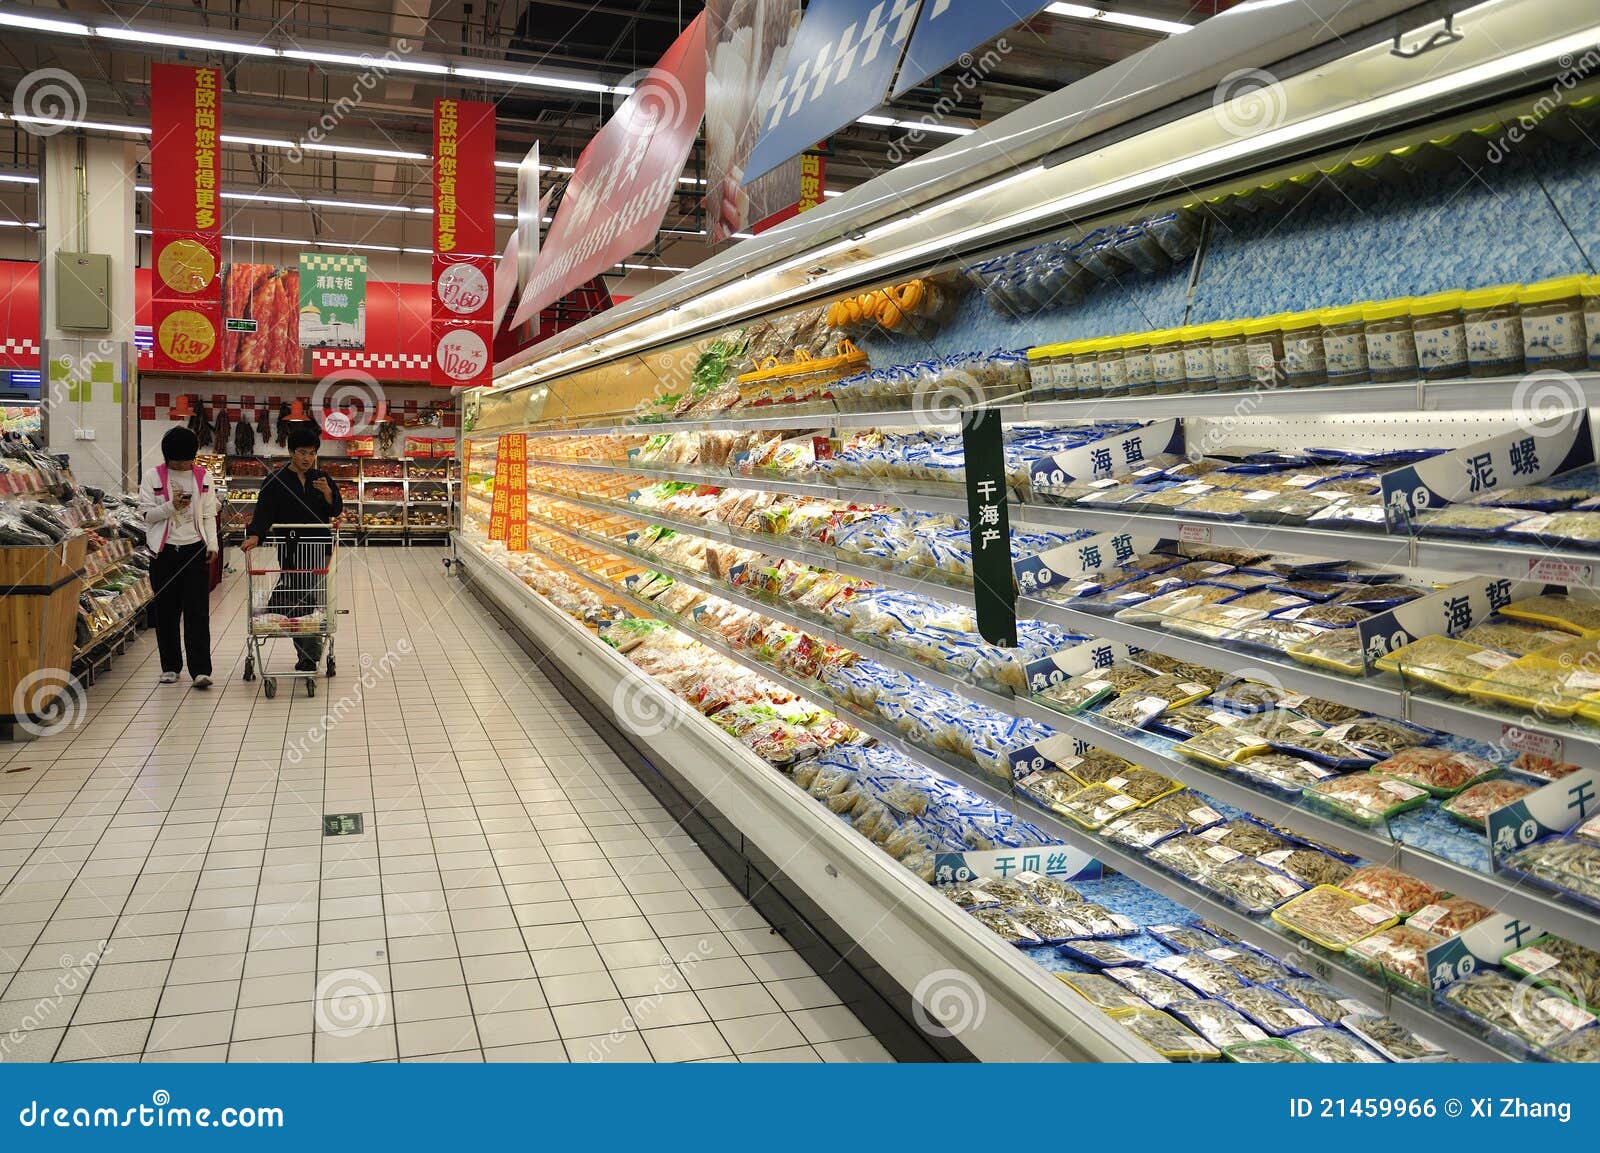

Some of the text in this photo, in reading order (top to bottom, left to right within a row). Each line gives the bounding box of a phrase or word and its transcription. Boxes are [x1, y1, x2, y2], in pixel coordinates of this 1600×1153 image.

[195, 68, 216, 229] 在欧尚您省得更多
[438, 99, 458, 252] 在欧尚您省得更多
[1090, 437, 1145, 474] 海蜇
[1466, 436, 1540, 493] 泥螺
[977, 480, 1001, 550] 干海产
[1078, 533, 1135, 571] 海蜇
[994, 853, 1068, 879] 干贝丝
